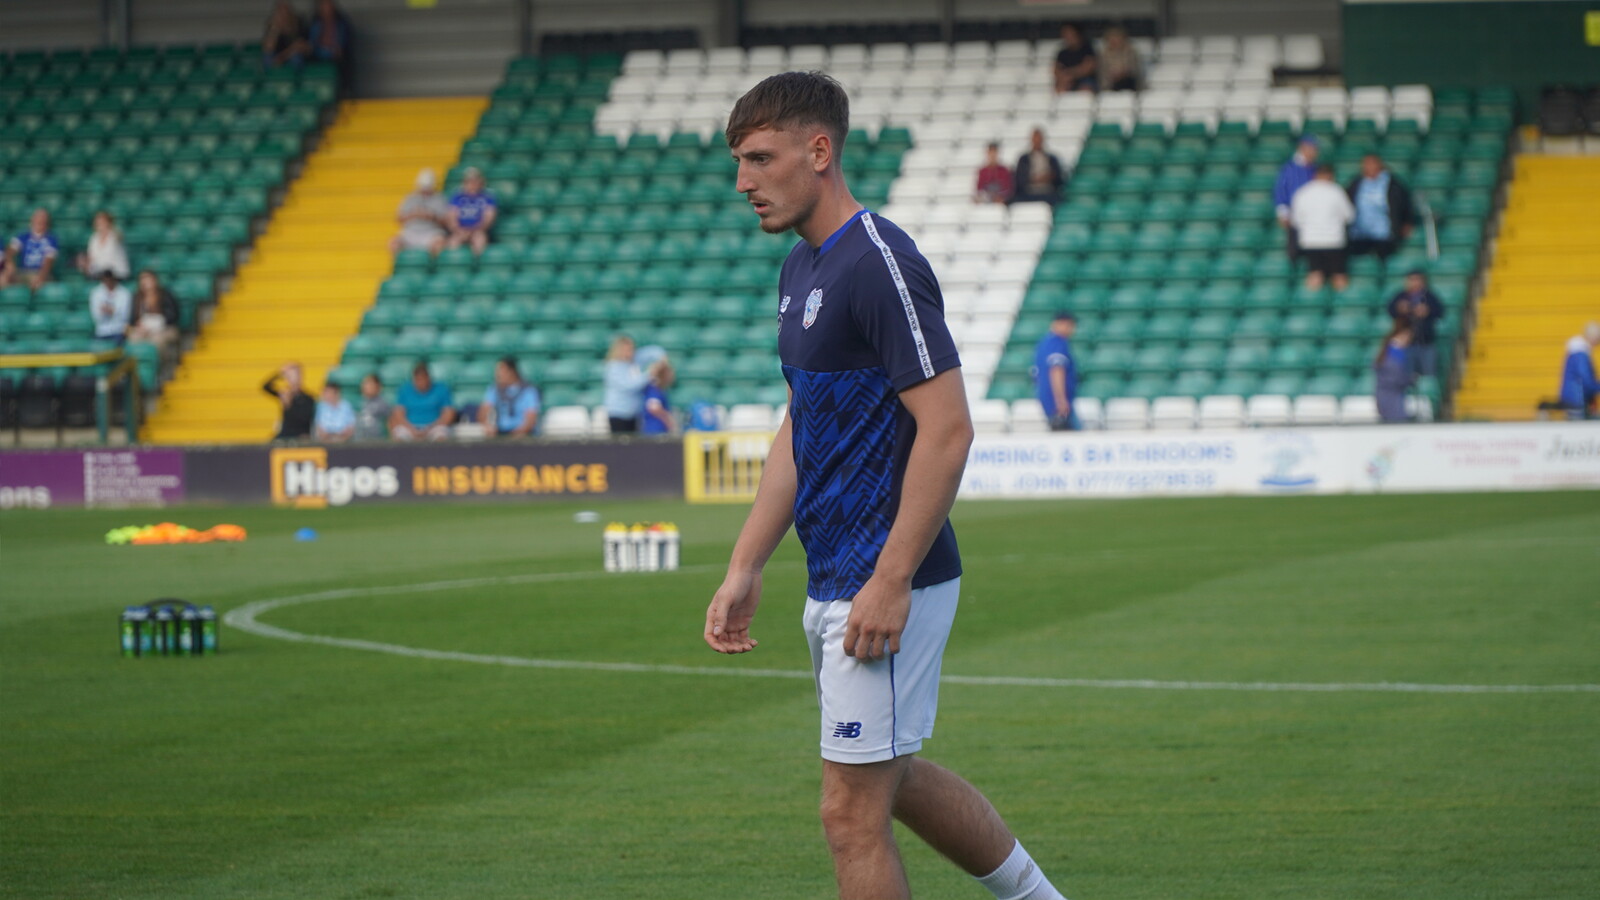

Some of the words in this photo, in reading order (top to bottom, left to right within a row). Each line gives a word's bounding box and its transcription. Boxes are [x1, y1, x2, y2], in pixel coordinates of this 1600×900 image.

[1084, 442, 1236, 466] BATHROOMS
[285, 460, 399, 505] Higos
[412, 464, 608, 495] INSURANCE
